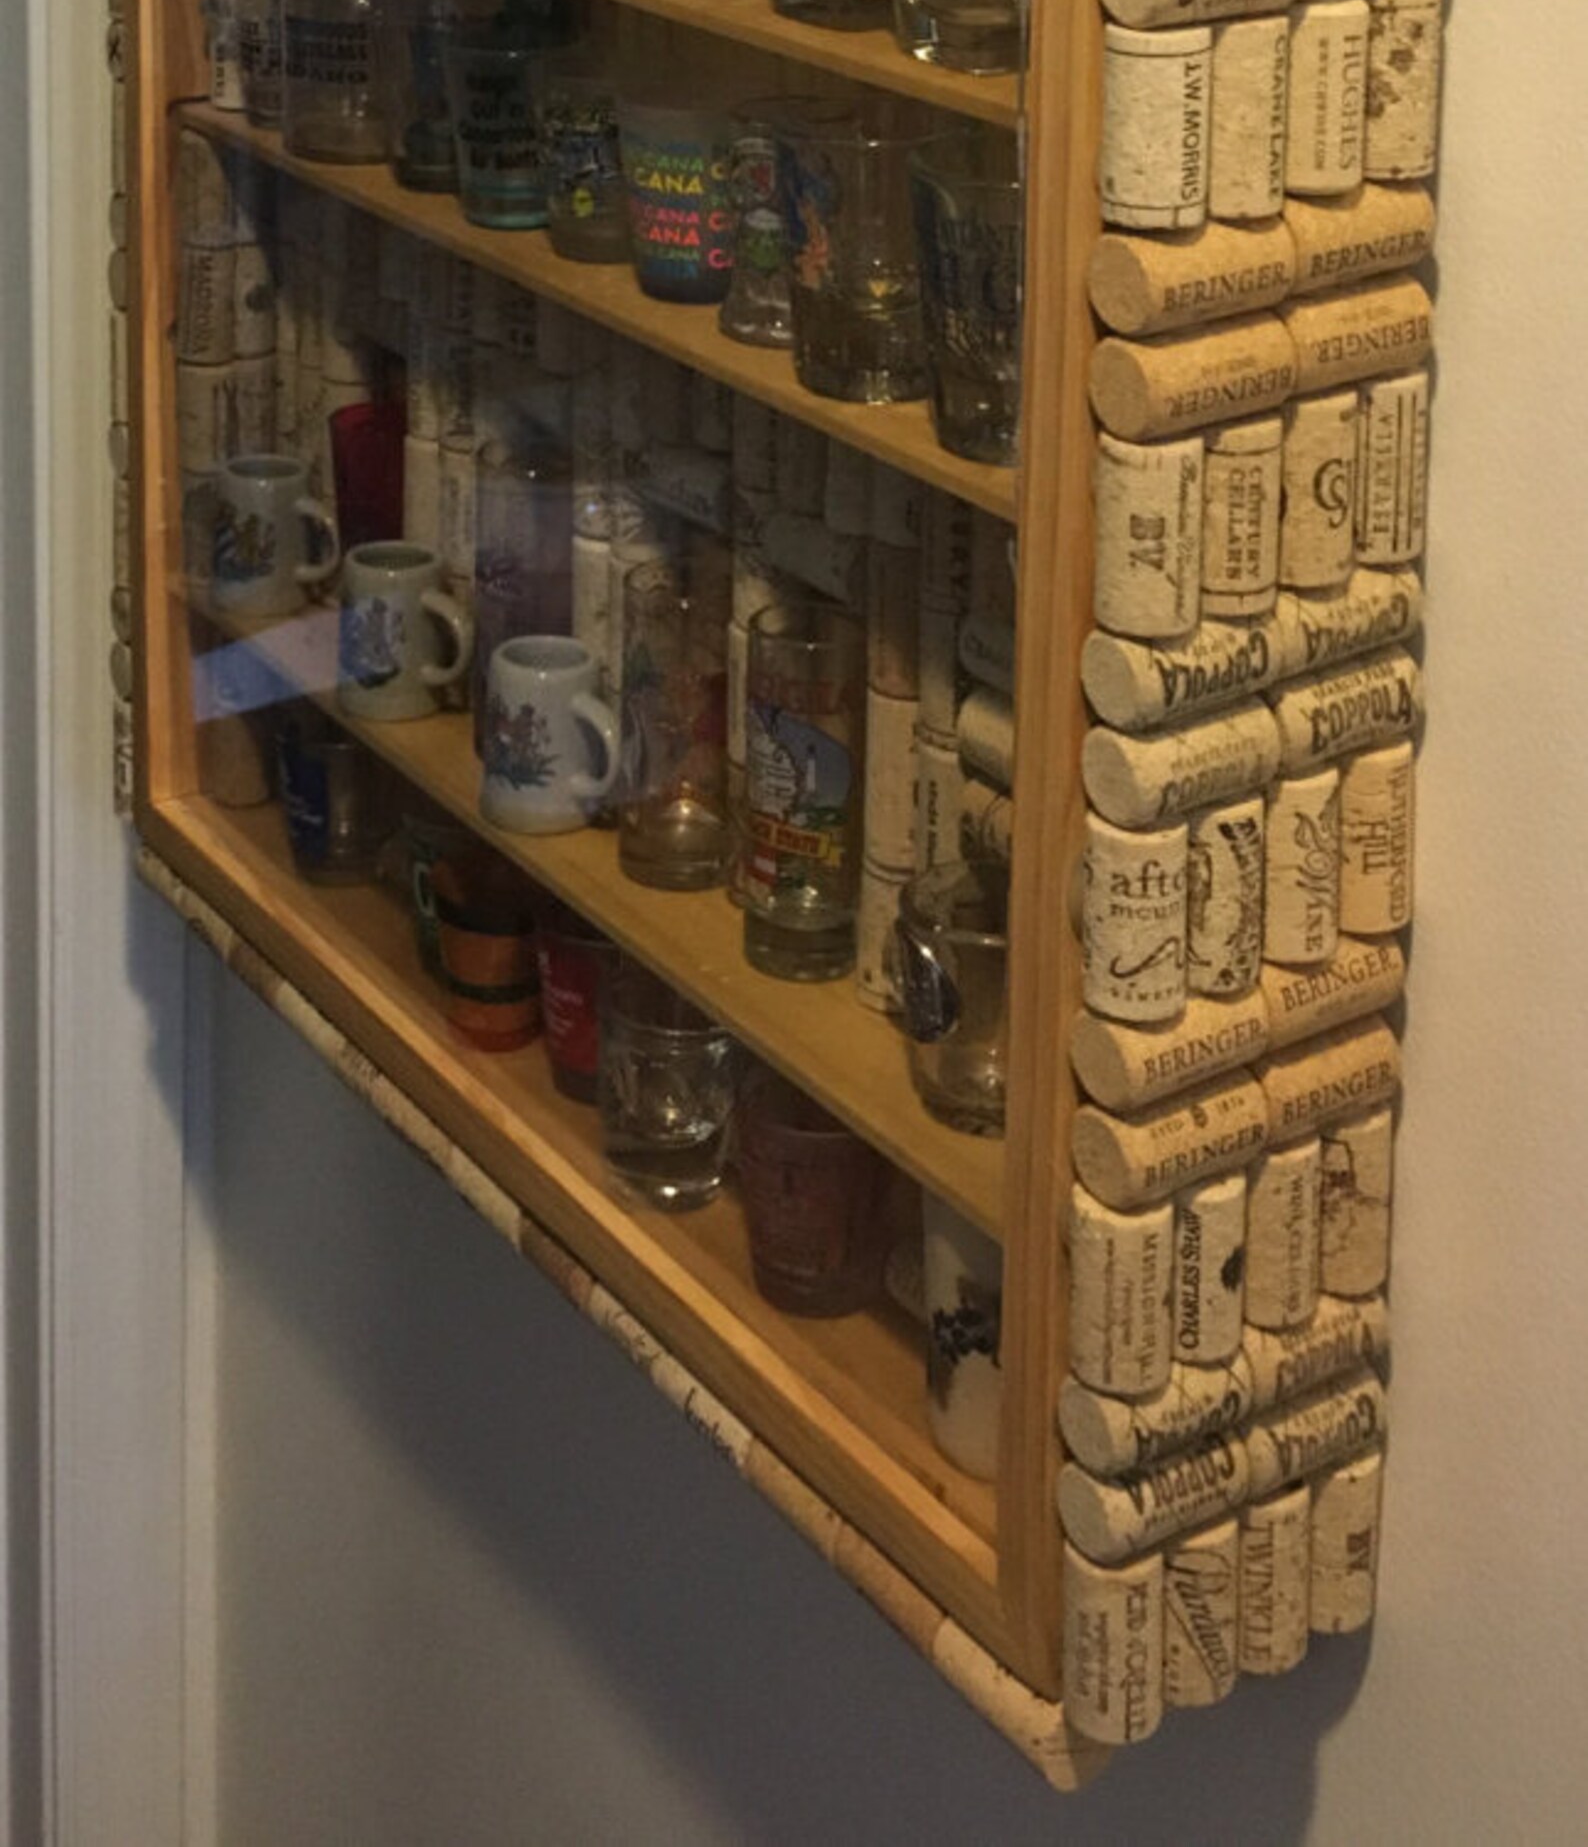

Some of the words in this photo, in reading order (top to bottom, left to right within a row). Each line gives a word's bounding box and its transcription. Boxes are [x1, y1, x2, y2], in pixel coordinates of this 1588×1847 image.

[1338, 33, 1364, 172] HUGHES
[1224, 466, 1243, 582] CELLARS
[1308, 677, 1414, 752] COPPOLA
[1178, 1265, 1202, 1351] CHARLES
[1242, 1520, 1275, 1662] TWINKLE
